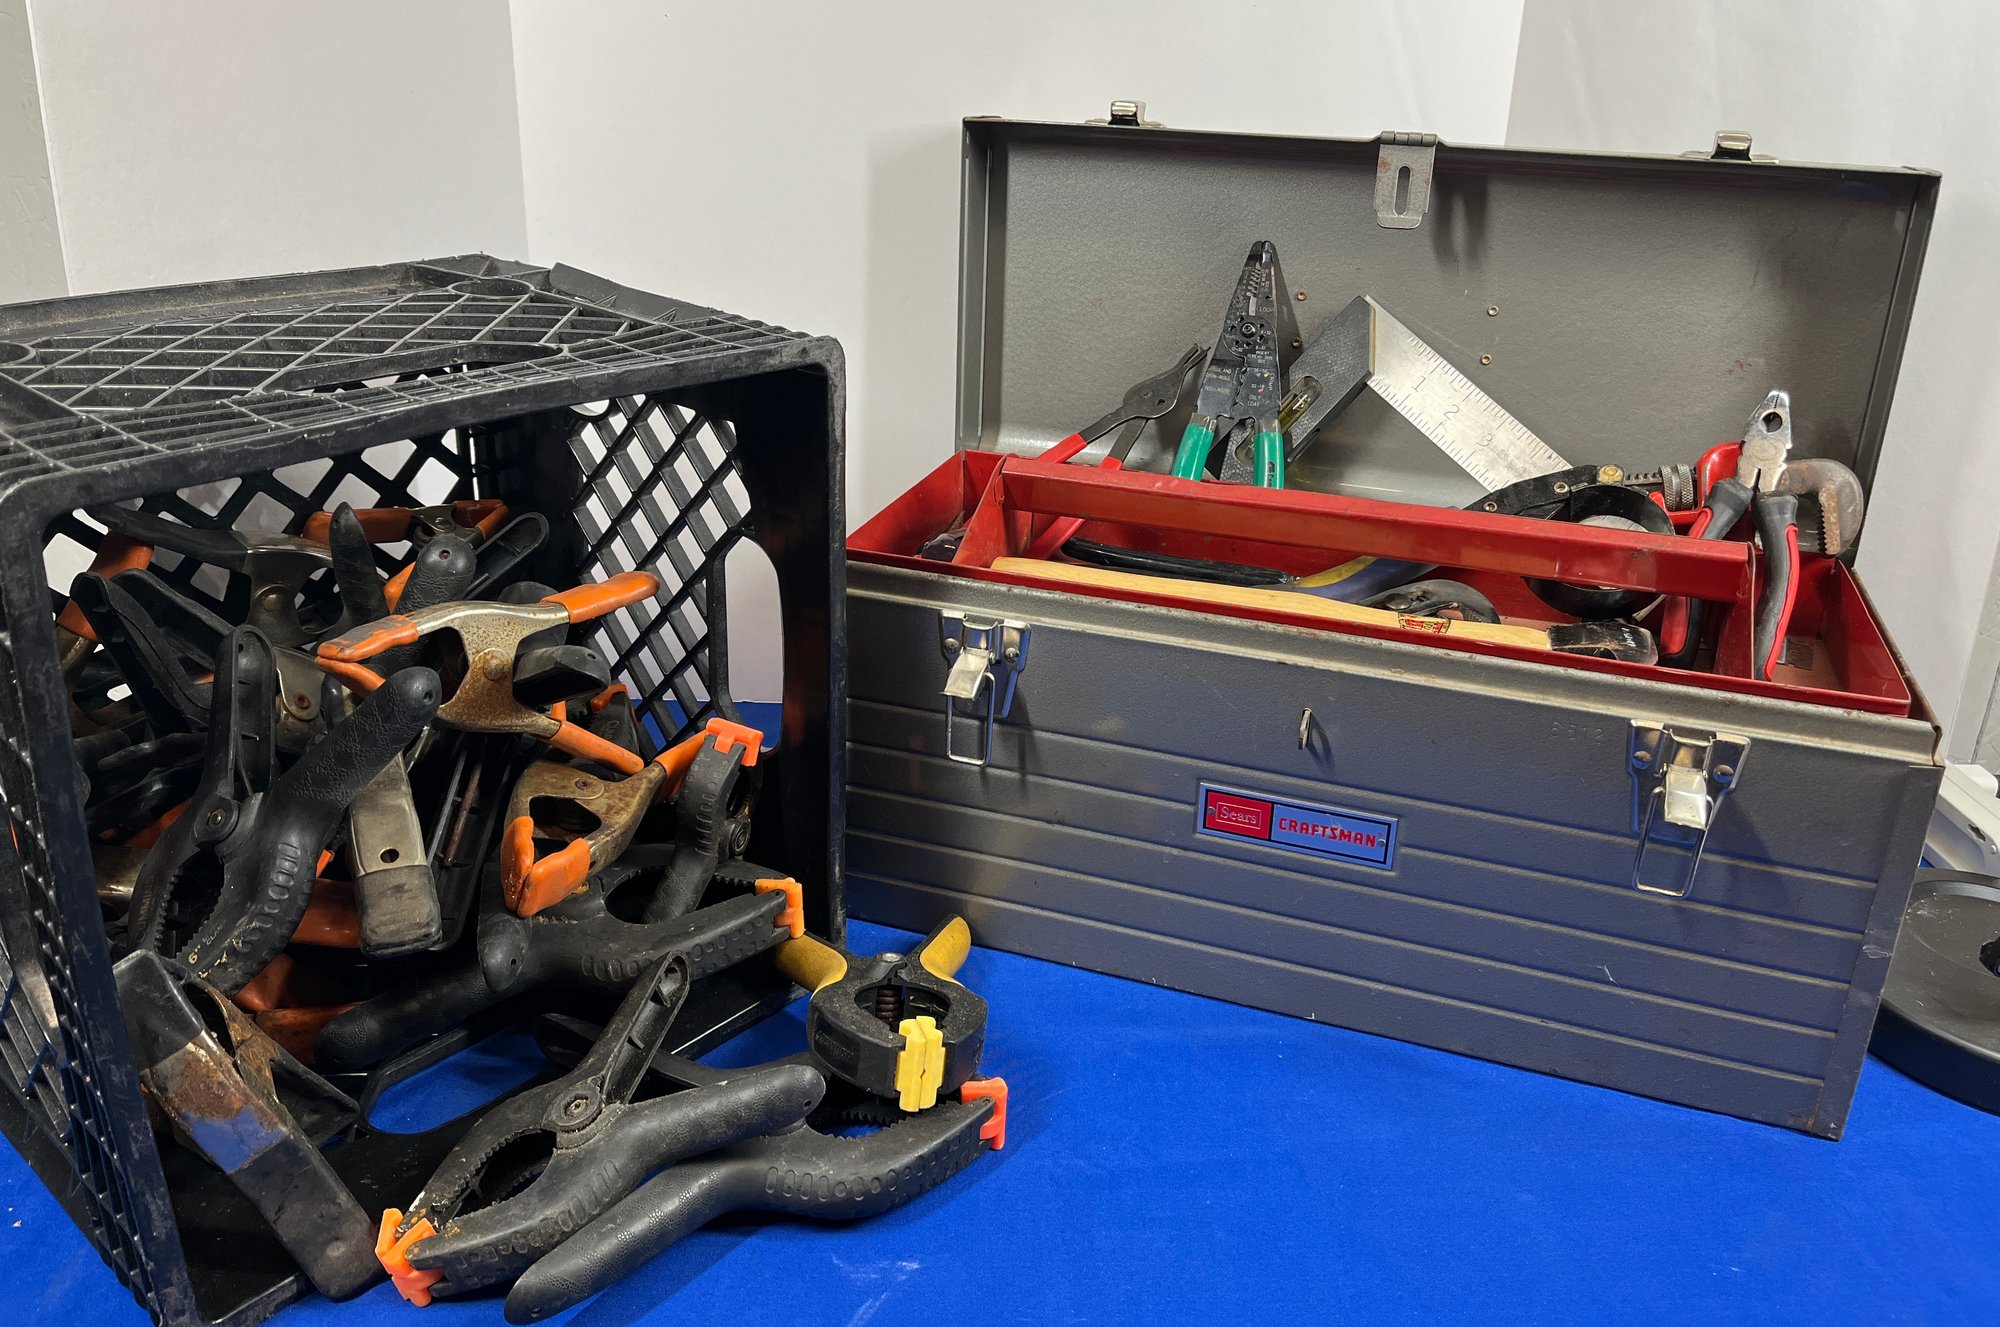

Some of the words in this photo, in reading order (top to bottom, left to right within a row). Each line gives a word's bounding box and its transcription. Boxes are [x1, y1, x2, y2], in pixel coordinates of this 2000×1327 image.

[1412, 375, 1427, 393] 1
[1443, 404, 1460, 421] 2
[1476, 433, 1494, 448] 3
[1220, 806, 1258, 825] Sears
[1278, 817, 1377, 848] CRAFTSMAN
